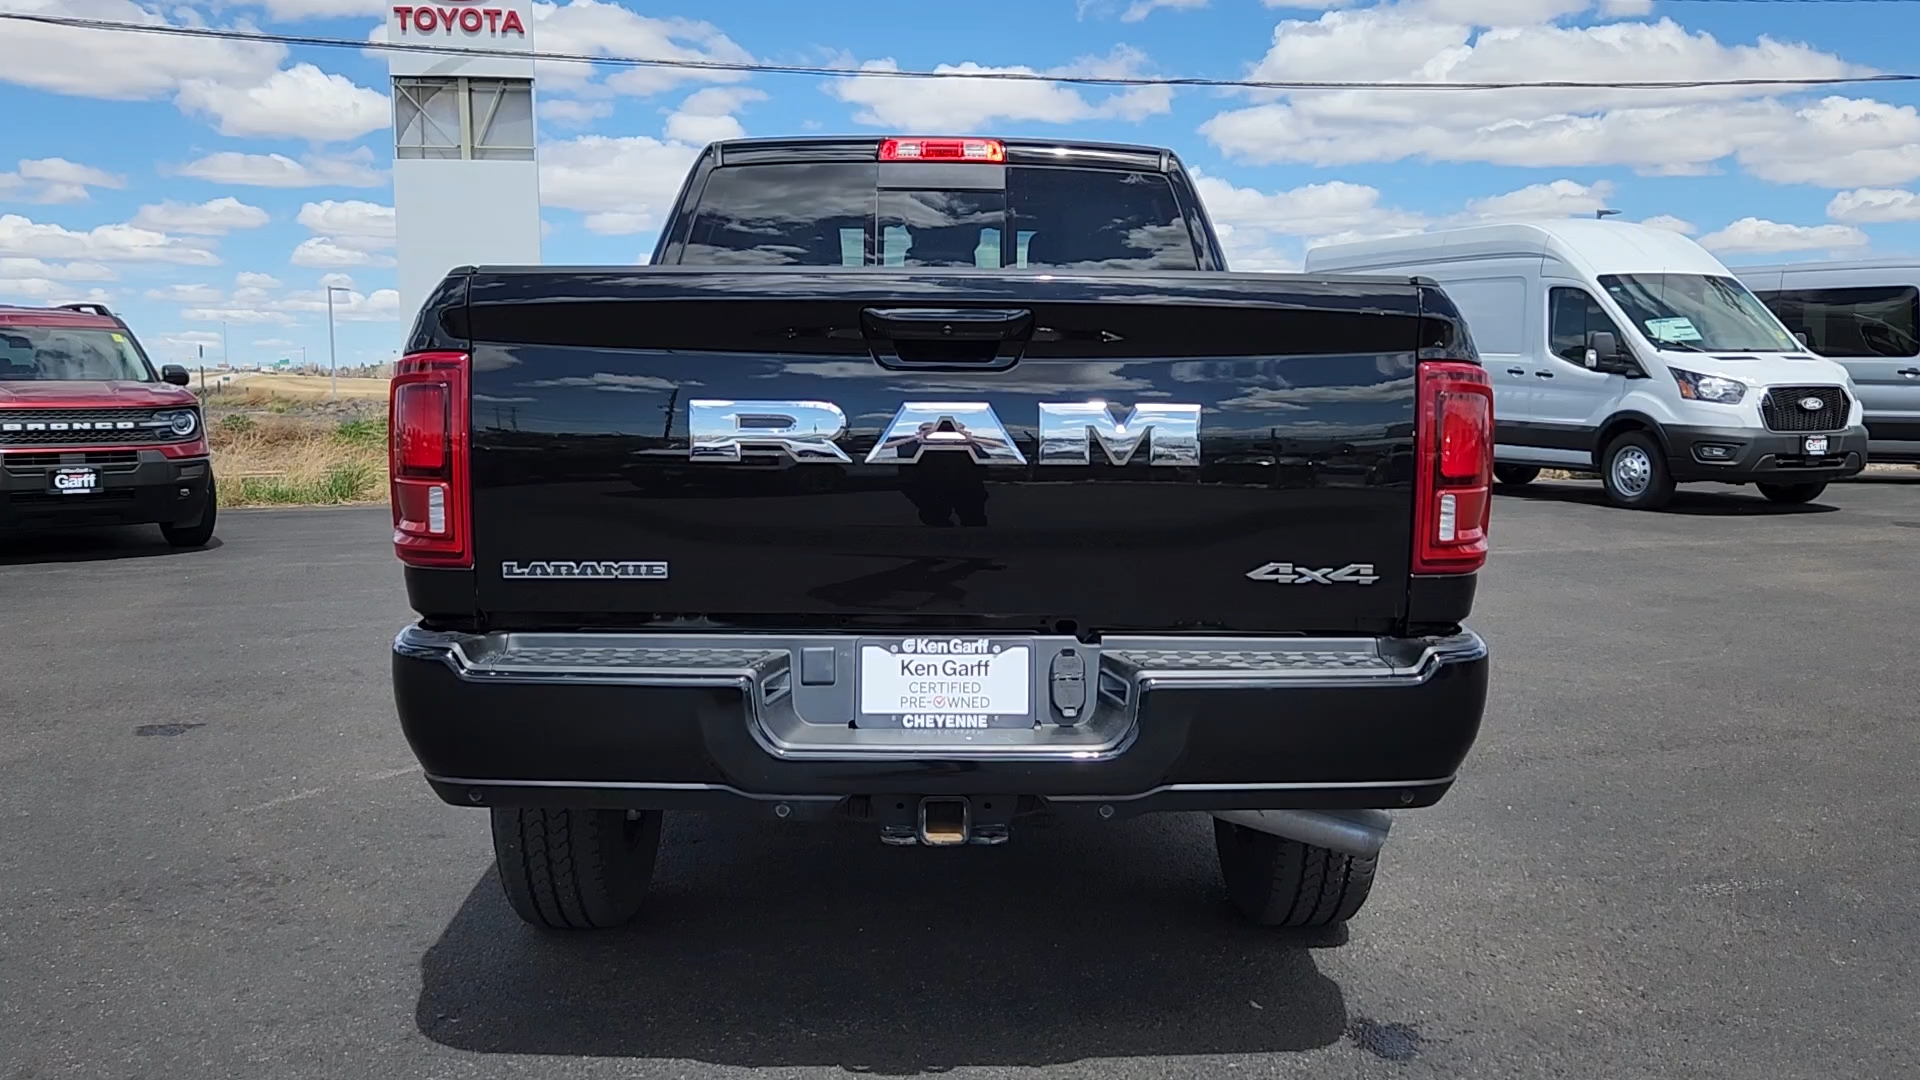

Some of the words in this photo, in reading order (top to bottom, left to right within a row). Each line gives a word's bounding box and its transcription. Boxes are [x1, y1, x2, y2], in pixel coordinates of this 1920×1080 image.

[393, 6, 525, 34] TOYOTA
[2, 421, 135, 431] BRONCO
[689, 399, 1202, 466] RAM
[54, 473, 97, 489] Garff
[502, 561, 669, 579] LARAMIE
[1245, 562, 1380, 585] 4x4
[916, 638, 948, 654] Ken
[949, 638, 989, 654] Garff
[901, 659, 938, 677] Ken
[942, 659, 990, 677] Garff
[908, 681, 981, 694] CERTIFIED
[902, 714, 988, 728] CHEYENNE
